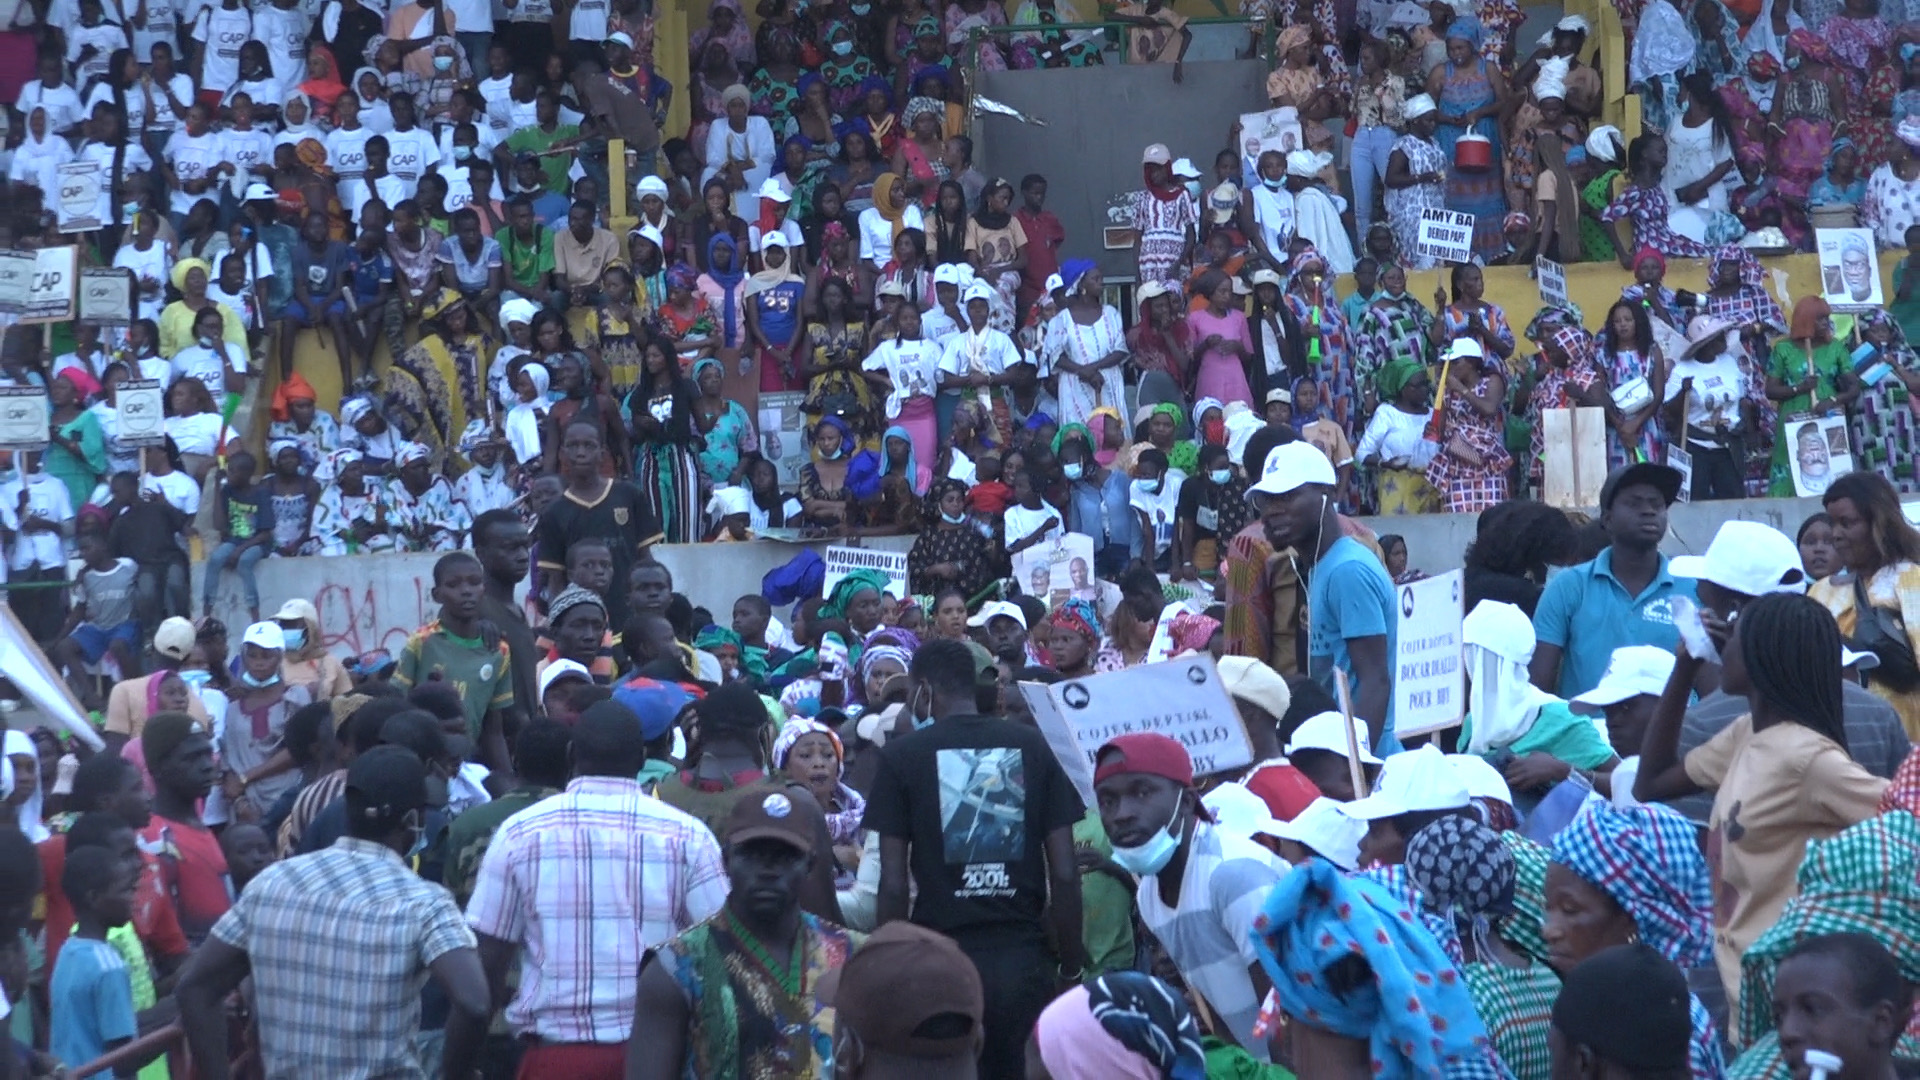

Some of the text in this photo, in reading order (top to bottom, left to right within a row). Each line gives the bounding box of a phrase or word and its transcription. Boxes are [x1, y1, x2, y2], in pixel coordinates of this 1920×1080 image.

[219, 31, 245, 44] CAP
[236, 150, 259, 161] CAP
[339, 153, 363, 166] CAP
[392, 154, 416, 166] CAP
[178, 161, 200, 173] CAP
[61, 185, 83, 198] CAP
[1422, 208, 1473, 227] AMY BA
[1450, 230, 1466, 244] PAPE
[30, 272, 62, 293] CAP
[124, 402, 145, 414] CAP
[827, 550, 907, 571] MOUNIROU LY
